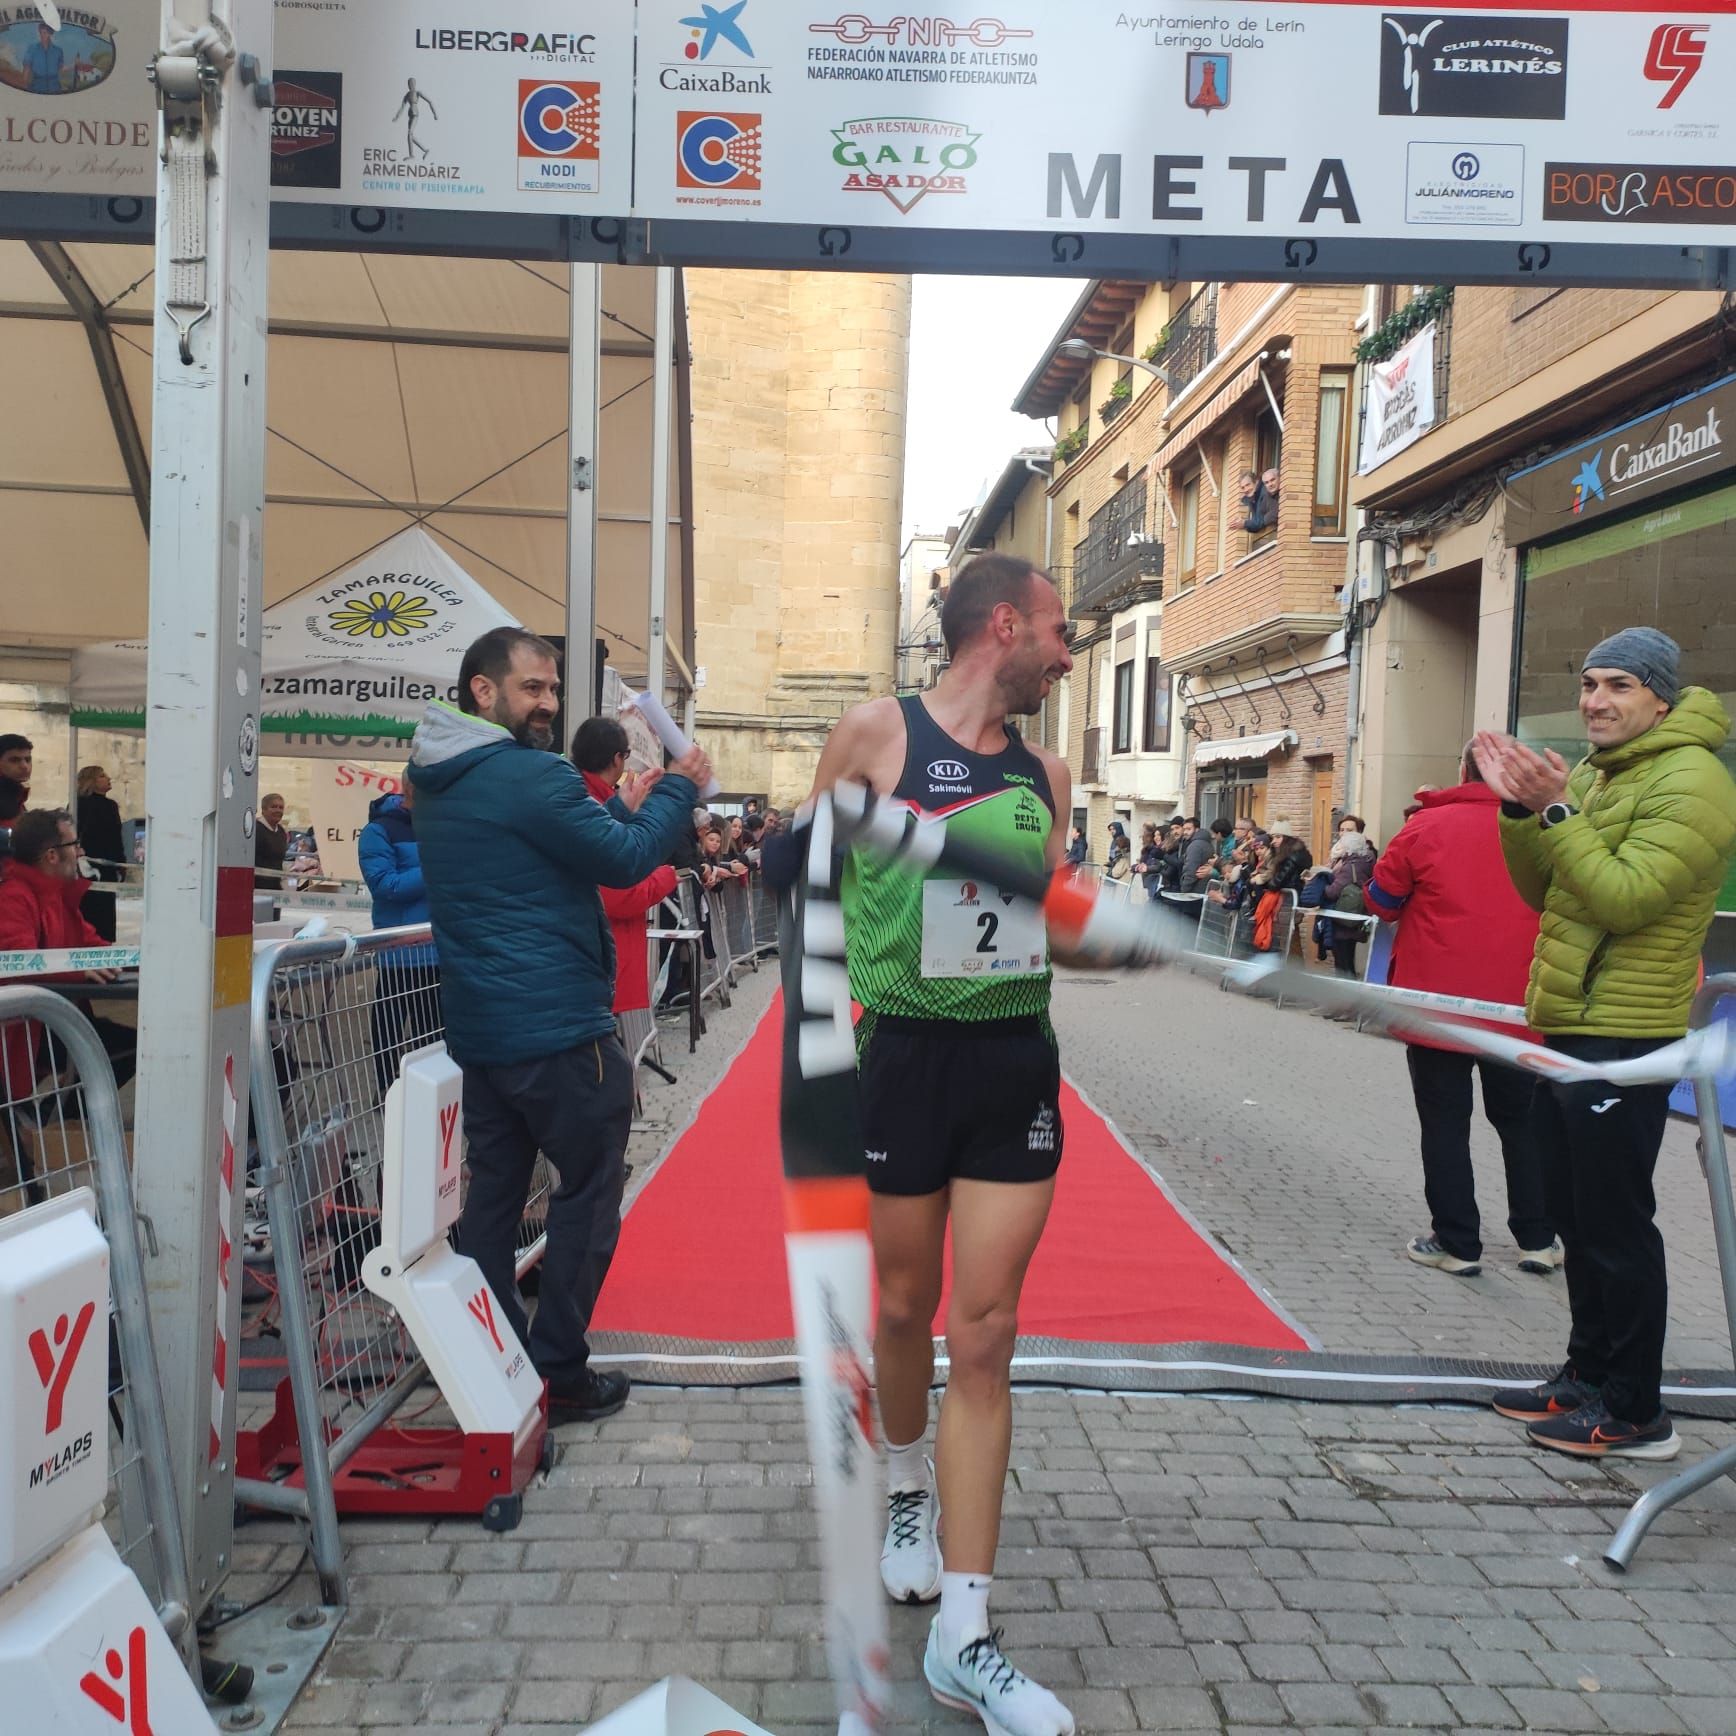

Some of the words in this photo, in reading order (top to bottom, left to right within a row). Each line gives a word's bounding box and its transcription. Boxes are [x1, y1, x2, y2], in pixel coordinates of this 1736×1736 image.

[16, 7, 100, 29] AGRULTOR
[1115, 13, 1230, 32] Ayuntamiento
[1238, 17, 1258, 31] de
[1155, 32, 1212, 51] Leringo
[1220, 33, 1265, 49] Udala
[1442, 40, 1481, 53] CLUB
[1482, 39, 1555, 55] ATLÉTICO
[546, 54, 595, 64] DIGITAL
[808, 45, 885, 63] FEDERACIÓN
[889, 49, 947, 65] NAVARRA
[951, 51, 966, 66] DE
[970, 52, 1038, 67] ATLETISMO
[1432, 57, 1563, 75] LERINÉS
[659, 68, 773, 95] CaixaBank
[808, 66, 884, 82] NAFARROAKO
[886, 68, 947, 83] ATLETISMO
[950, 70, 1038, 86] FEDERAKUNTZA
[272, 107, 338, 127] OYEN
[0, 117, 151, 147] LCONDE
[271, 125, 320, 138] RTINEZ
[849, 123, 875, 136] BAR
[876, 121, 965, 138] RESTAURANTE
[363, 148, 398, 162] ERIC
[832, 141, 978, 170] GALO
[362, 162, 461, 180] ARMENDÁRIZ
[541, 164, 576, 178] NODI
[362, 180, 401, 191] CENTRO
[524, 181, 592, 191] RECUBRIMIENTOS
[844, 173, 968, 190] ASADOR
[1046, 152, 1361, 224] META
[1608, 406, 1723, 484] CaixaBank
[316, 572, 464, 607] ZAMARGUILEA
[322, 634, 364, 648] Garten
[387, 639, 414, 649] 669
[416, 631, 441, 643] 032
[261, 676, 459, 702] .zamarguilea.c
[934, 764, 964, 776] KIA
[335, 765, 402, 794] STO
[928, 783, 973, 794] Sakimóvil
[327, 828, 344, 842] EL
[976, 912, 999, 953] 2
[29, 1431, 93, 1489] MYLAPS
